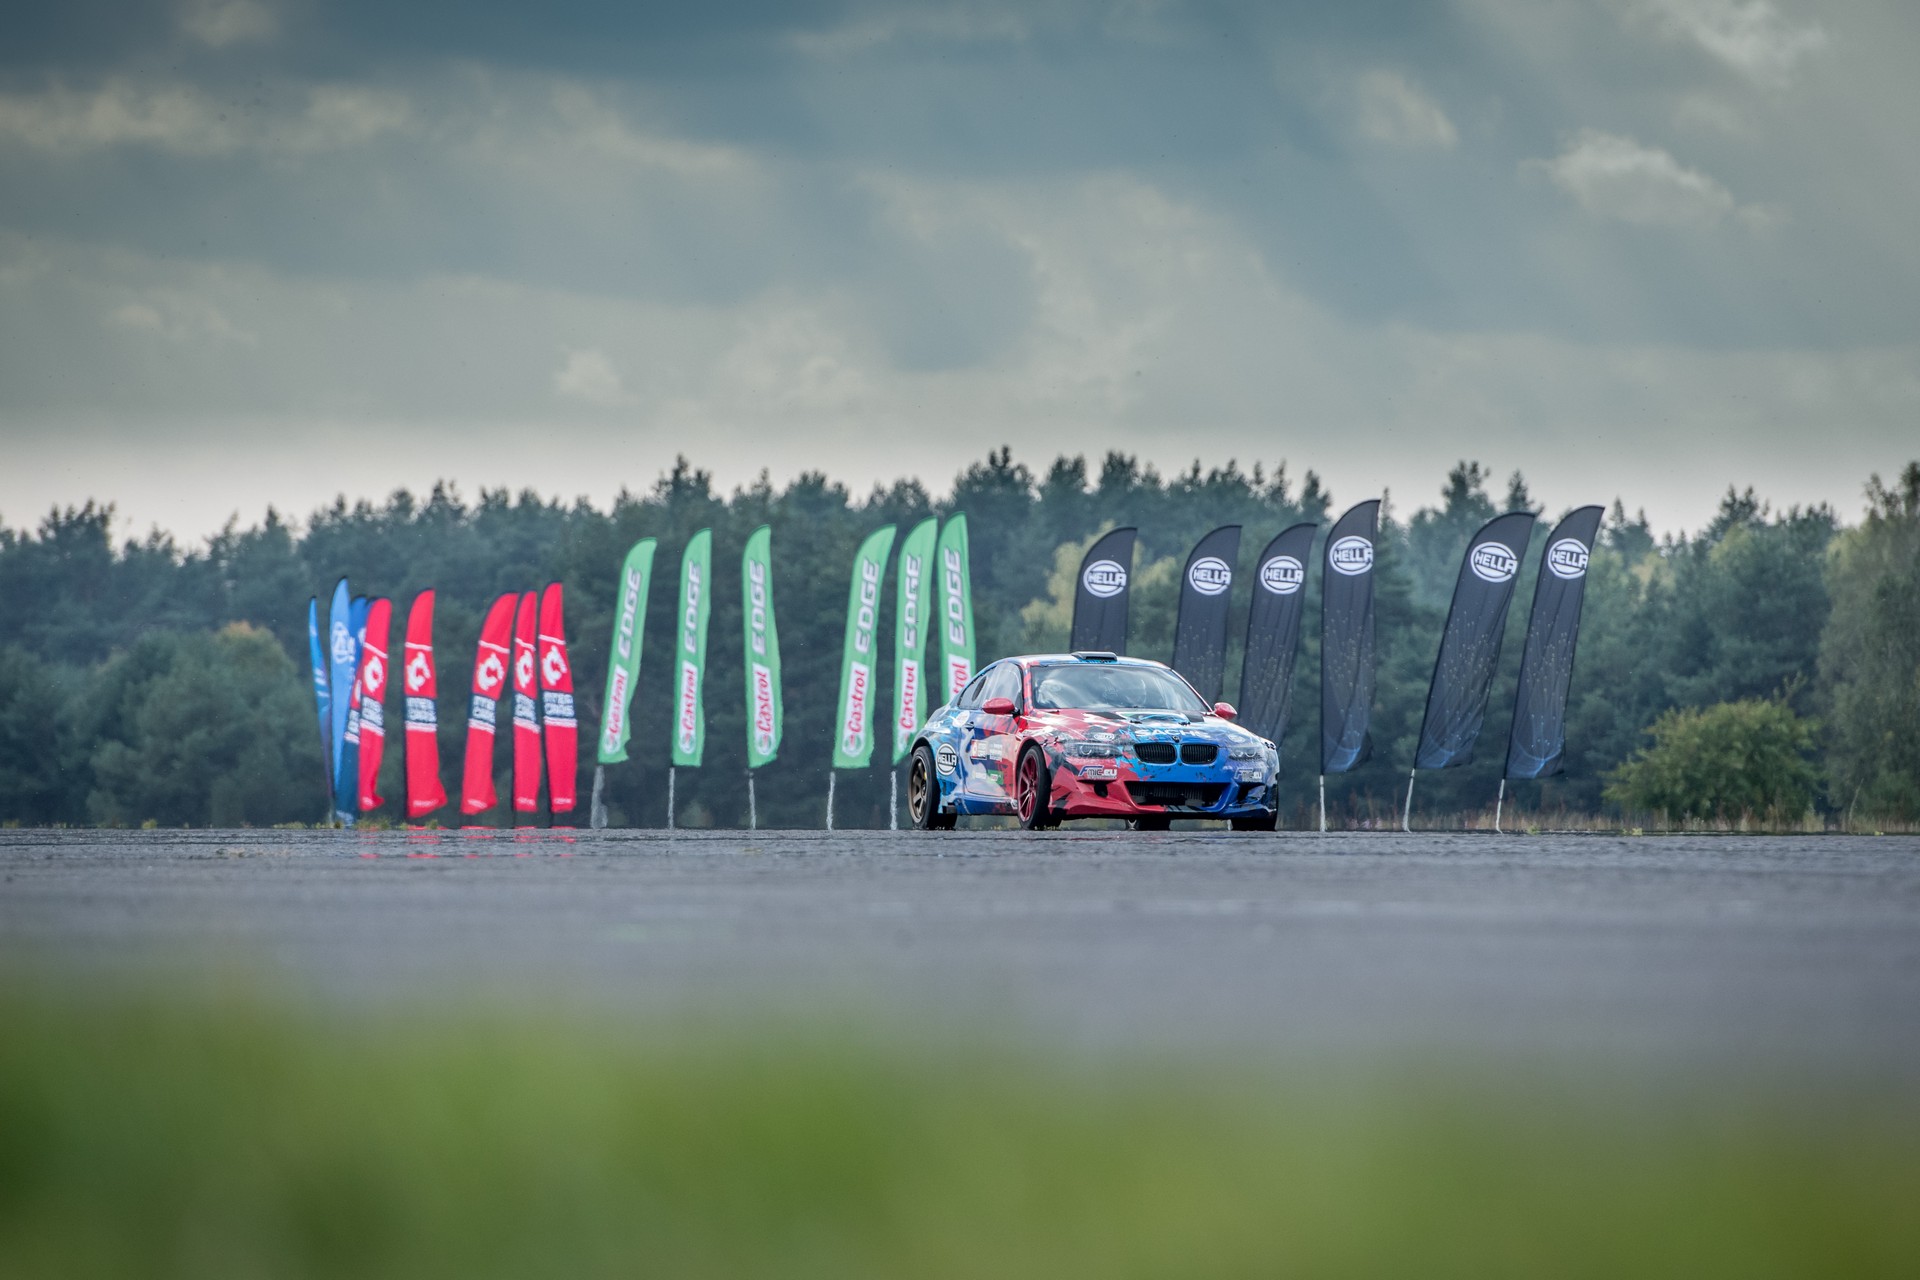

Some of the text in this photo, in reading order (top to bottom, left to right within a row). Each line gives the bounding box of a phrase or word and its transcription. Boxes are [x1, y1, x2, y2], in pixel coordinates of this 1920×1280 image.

[1088, 571, 1127, 587] HELLA
[1193, 568, 1231, 585] HELLA
[1265, 568, 1304, 584] HELLA
[1333, 548, 1373, 563] HELLA
[1474, 551, 1518, 575] HELLA
[1551, 550, 1589, 570] HELLA
[618, 565, 642, 661] EDGE
[684, 560, 701, 655] EDGE
[749, 558, 768, 657] EDGE
[854, 556, 880, 655] EDGE
[903, 552, 922, 649] EDGE
[944, 547, 967, 648] EDGE
[847, 669, 866, 734] Castrol
[898, 665, 916, 731] Castrol
